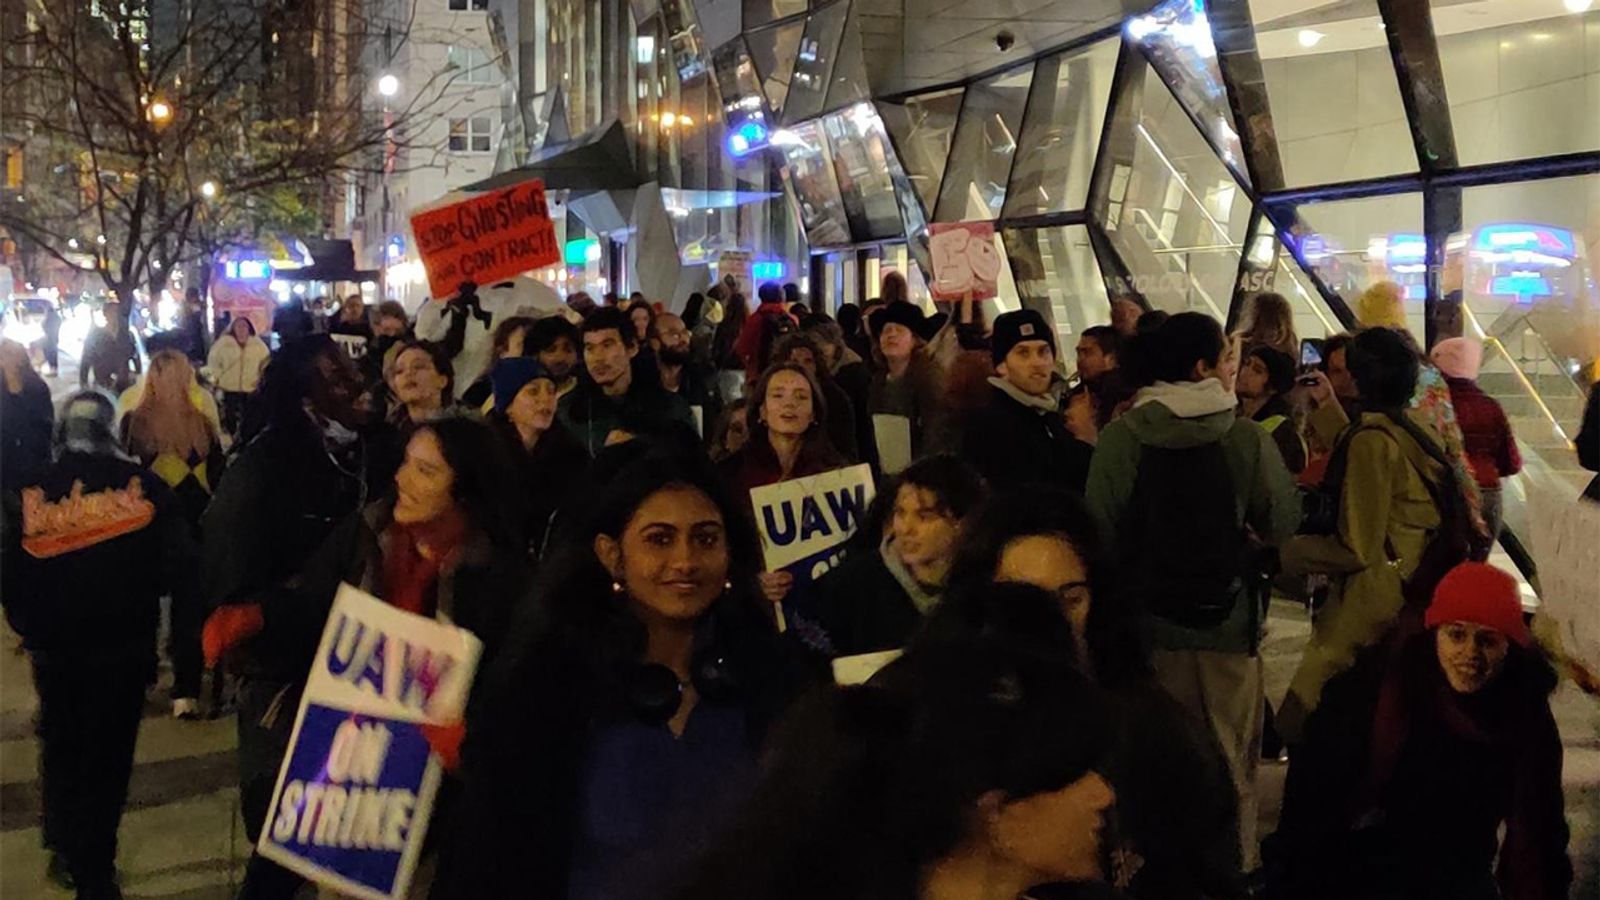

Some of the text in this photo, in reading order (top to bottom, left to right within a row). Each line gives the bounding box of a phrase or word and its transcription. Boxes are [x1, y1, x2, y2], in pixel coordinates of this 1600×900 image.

[420, 188, 548, 248] STOP GHOSTING
[459, 228, 555, 276] CONTRACT!
[761, 483, 865, 546] UAW
[326, 614, 455, 707] UAW
[326, 717, 393, 785] ON
[273, 778, 419, 850] STRIKE
